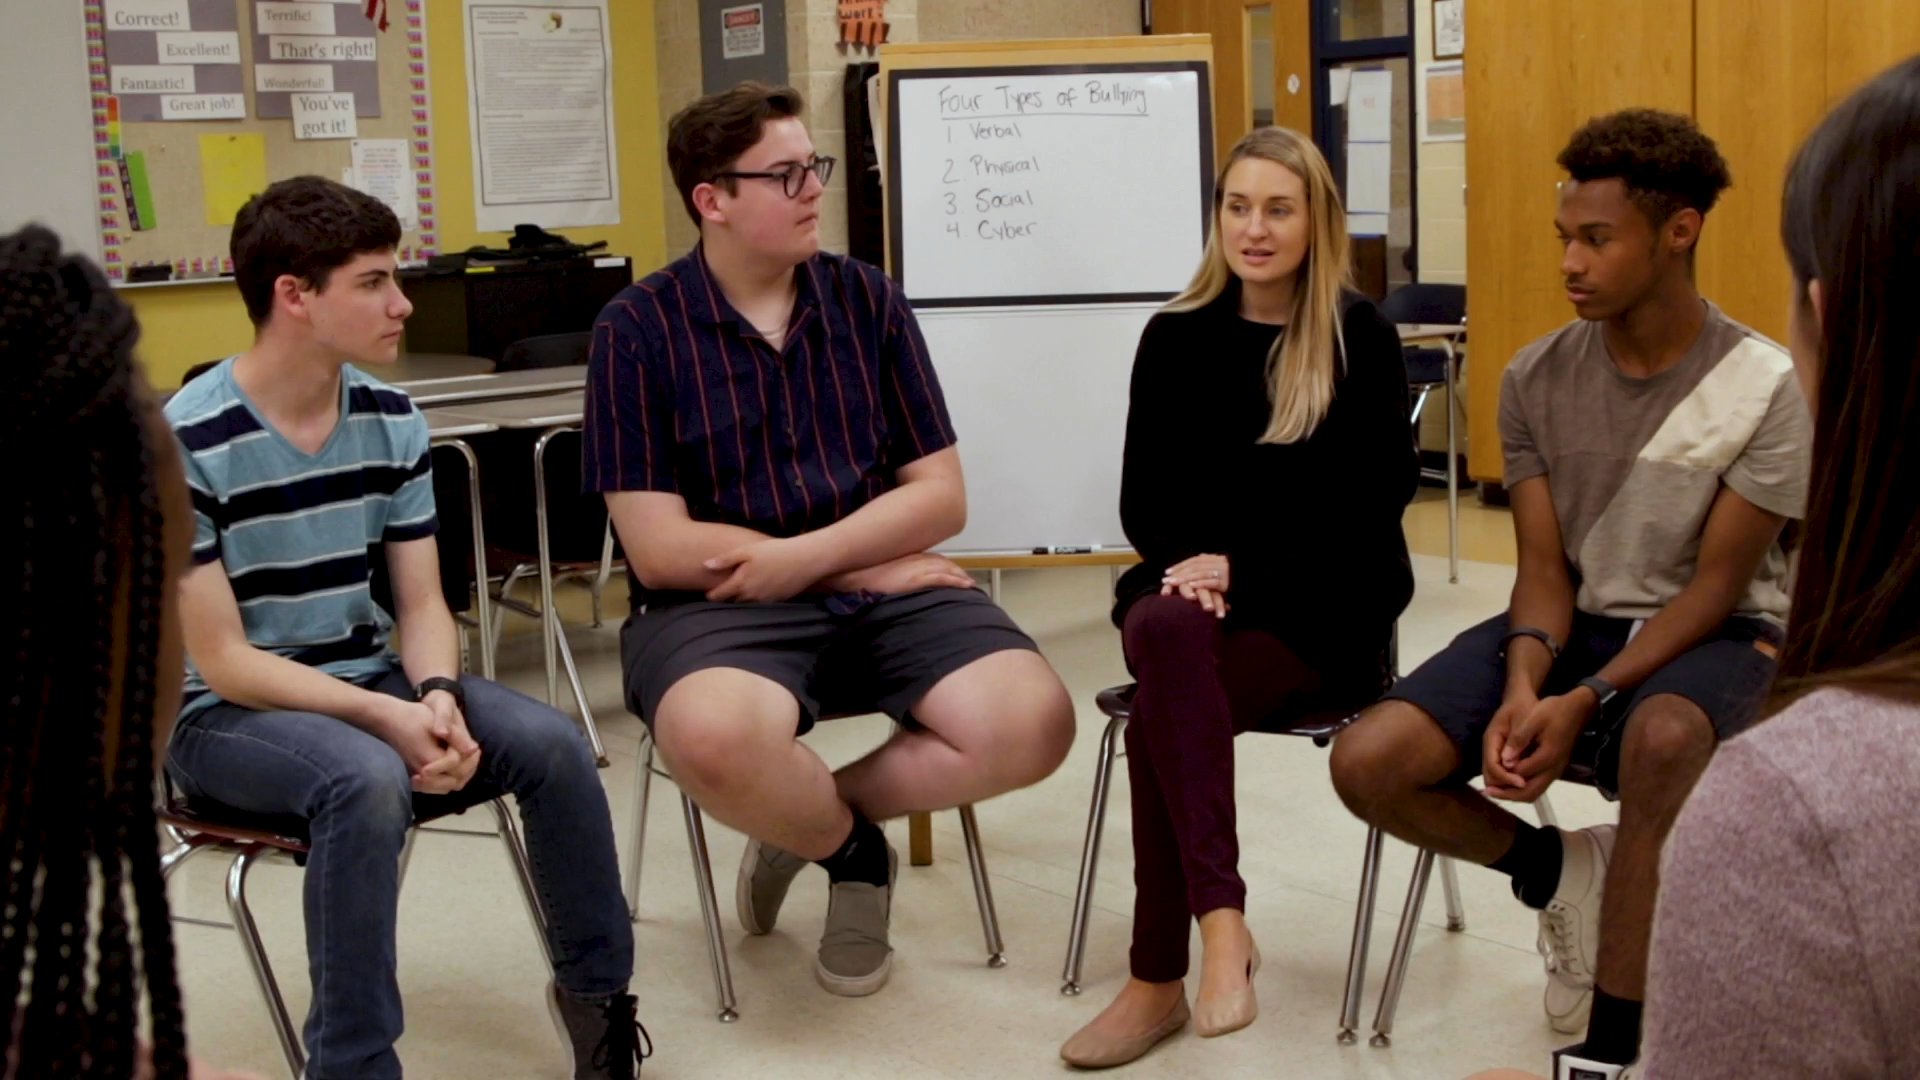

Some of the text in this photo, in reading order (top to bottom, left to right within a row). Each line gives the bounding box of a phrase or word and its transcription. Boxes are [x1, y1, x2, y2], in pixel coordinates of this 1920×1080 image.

[115, 10, 180, 26] Correct!
[264, 9, 311, 21] Terrific!
[166, 43, 230, 57] Excellent!
[277, 41, 373, 60] That's right!
[120, 77, 185, 91] Fantastic!
[263, 77, 325, 89] Wonderful!
[169, 97, 235, 112] Great job!
[299, 95, 349, 112] You've
[938, 80, 1147, 115] Four Types of Bullying
[302, 119, 347, 137] got it!
[969, 121, 1022, 140] Verbal
[969, 154, 1040, 176] Physical
[975, 187, 1034, 213] Social
[977, 219, 1038, 240] Cyber
